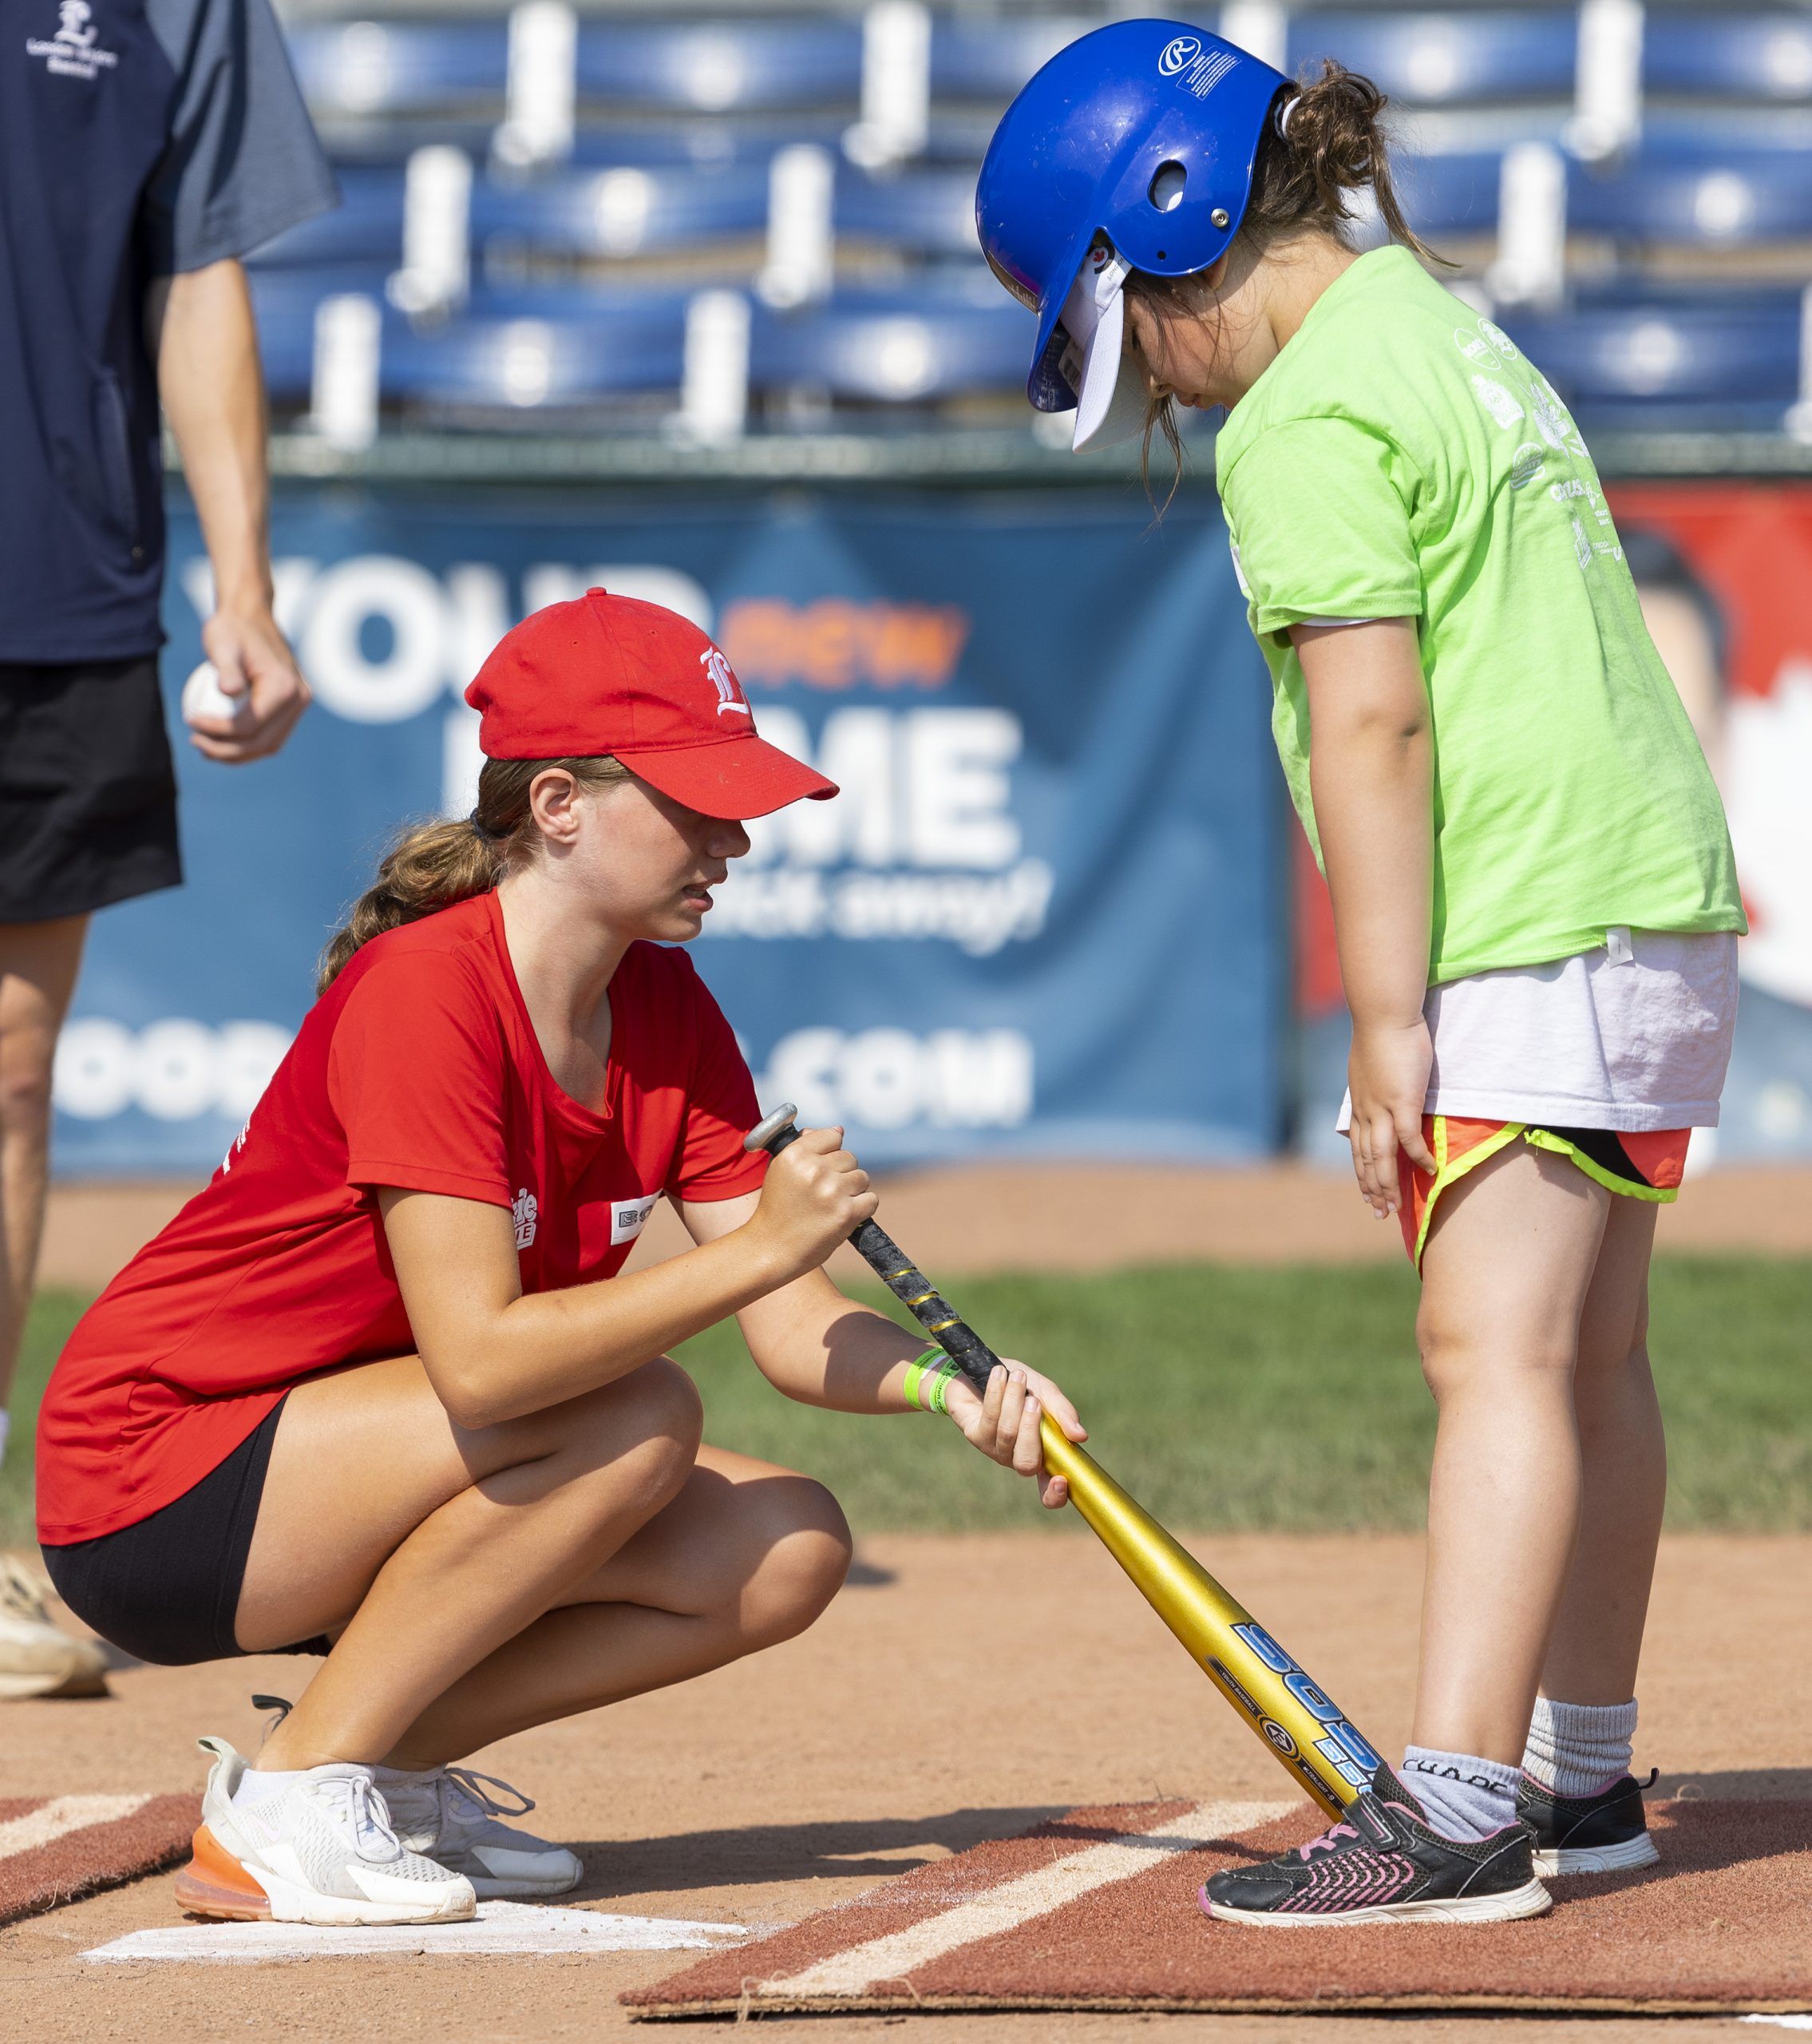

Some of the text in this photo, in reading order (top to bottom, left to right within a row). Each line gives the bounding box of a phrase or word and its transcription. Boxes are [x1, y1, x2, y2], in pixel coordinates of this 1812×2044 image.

[742, 1028, 1036, 1126] .COM
[1221, 1671, 1256, 1713] YOUTH BASEBALL
